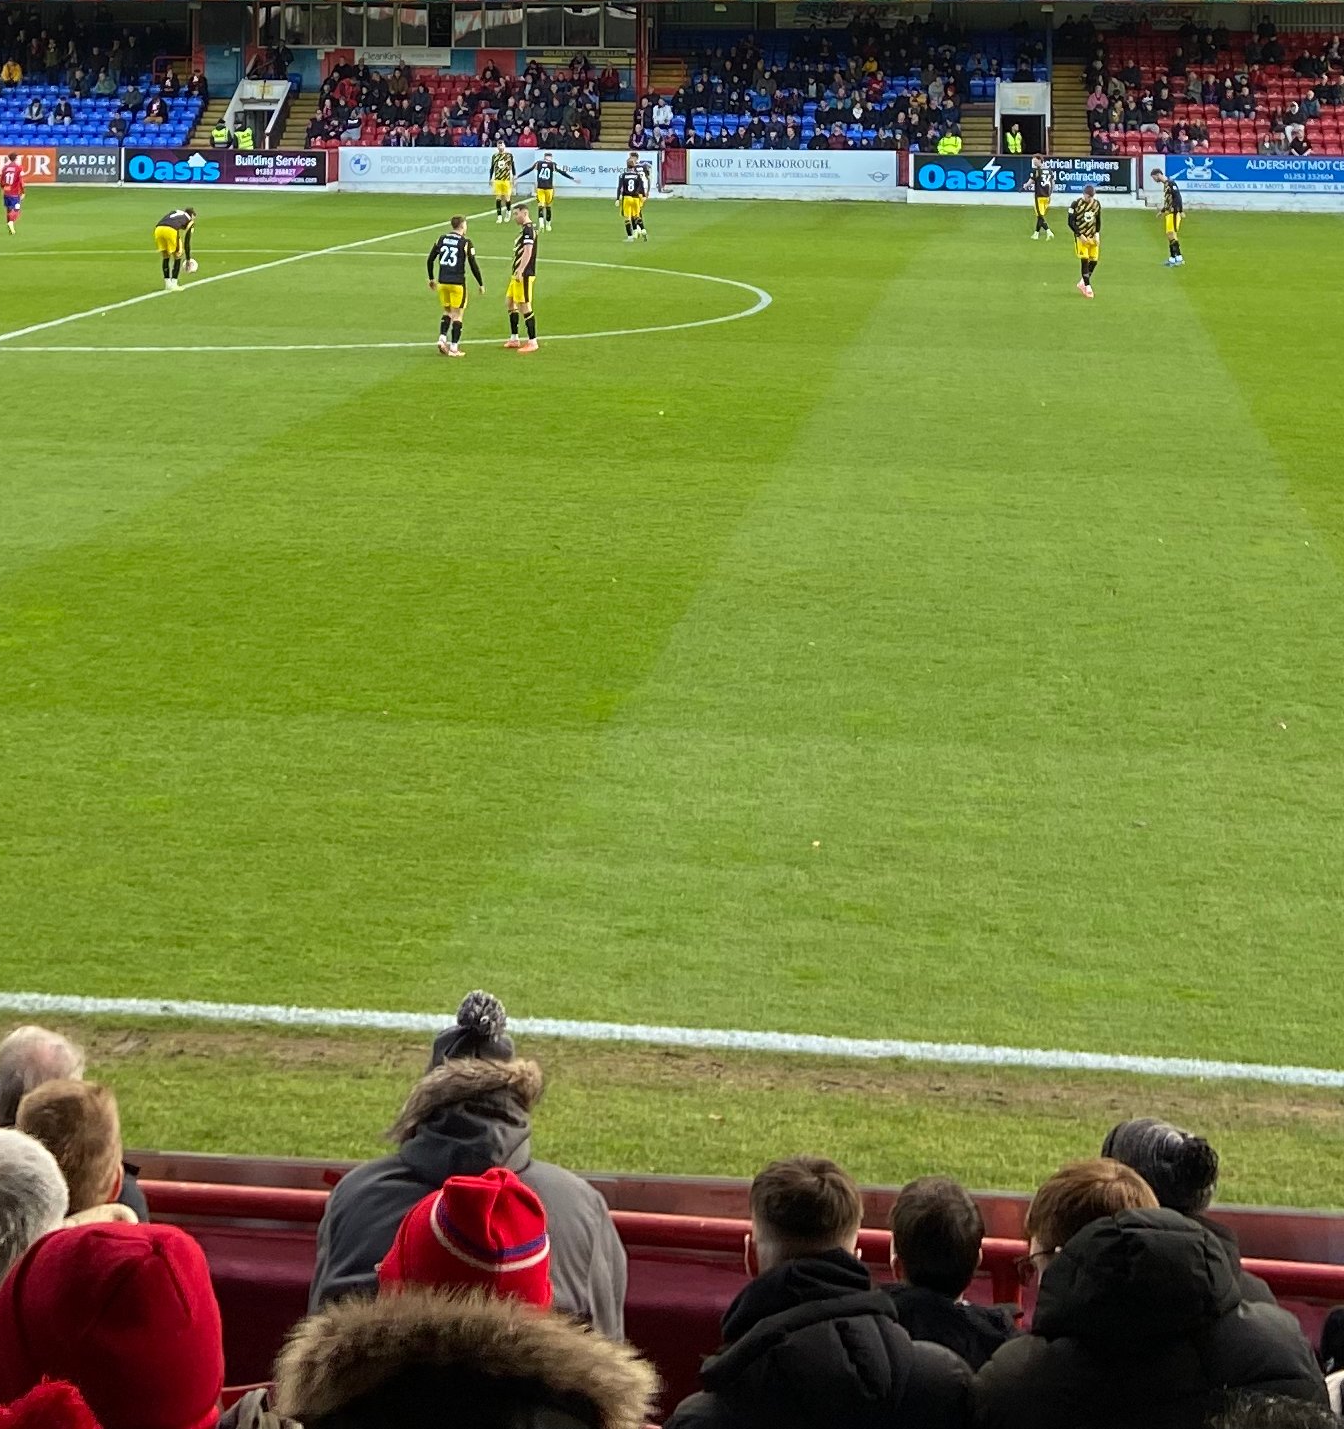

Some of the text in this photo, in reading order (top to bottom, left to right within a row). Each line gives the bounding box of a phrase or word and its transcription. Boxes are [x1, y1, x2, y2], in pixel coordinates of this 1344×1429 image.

[59, 155, 116, 166] GARDEN
[235, 154, 317, 168] Building Services
[380, 155, 423, 165] PROUDLY
[424, 155, 479, 165] SUPPORTED
[695, 158, 733, 169] GROUP
[1031, 159, 1119, 171] Ectrical Engineers
[1246, 159, 1305, 170] ALDERSHOT
[1307, 160, 1331, 171] MOT
[58, 166, 117, 176] MATERIALS
[128, 153, 220, 181] Oasis
[539, 166, 551, 180] 40
[562, 165, 596, 174] Building
[5, 171, 15, 185] 11
[918, 159, 1015, 190] Oasis
[1058, 170, 1111, 182] Contractors
[627, 179, 635, 192] 8
[439, 245, 459, 267] 23
